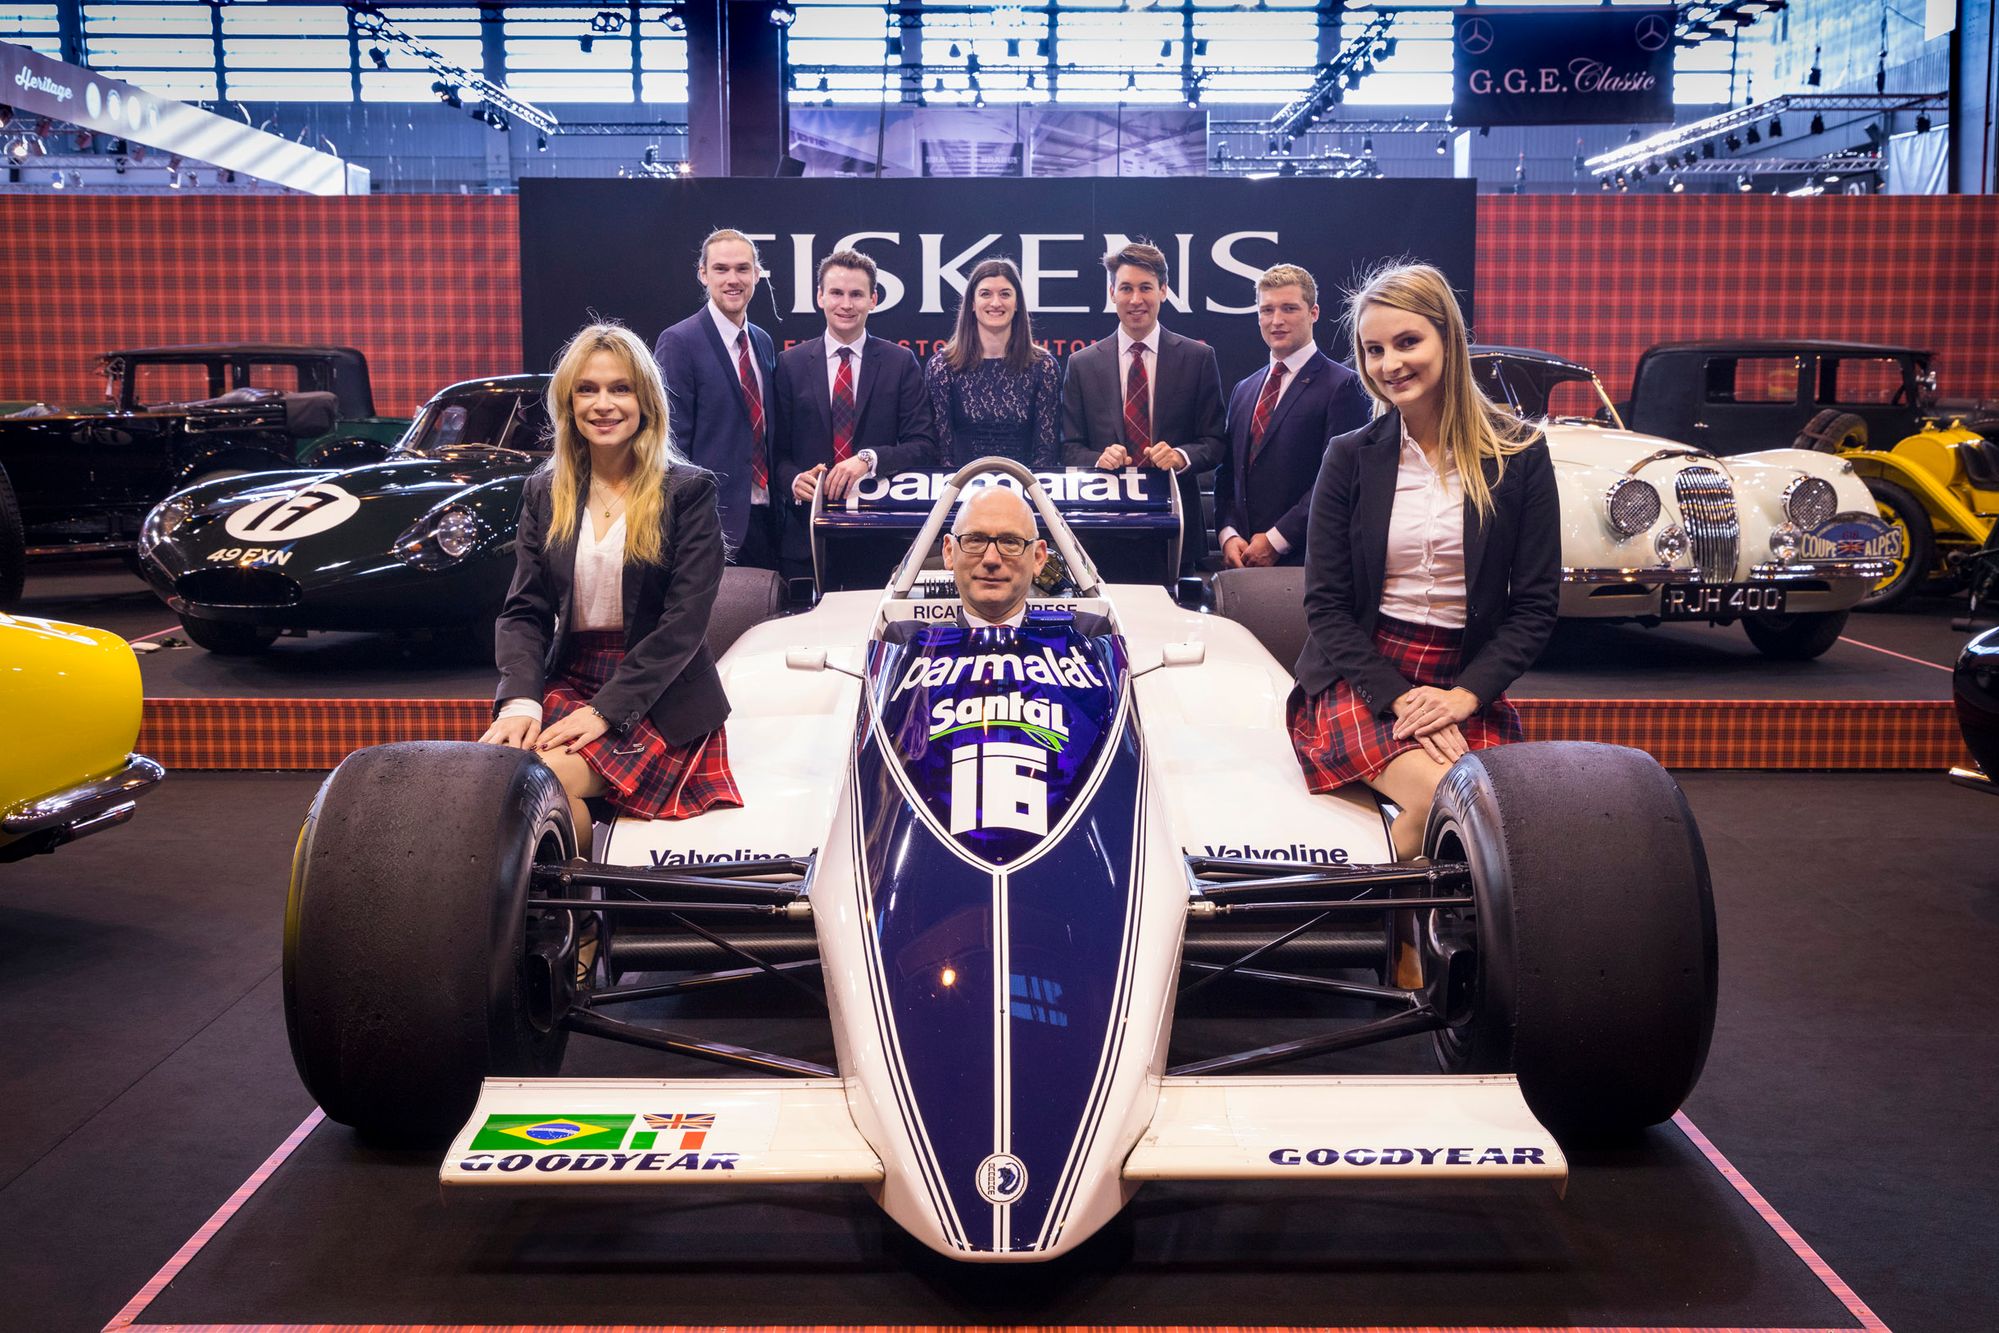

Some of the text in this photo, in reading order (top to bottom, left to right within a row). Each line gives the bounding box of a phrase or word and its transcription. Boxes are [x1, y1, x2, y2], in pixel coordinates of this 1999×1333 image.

[15, 66, 74, 102] Heritage
[1469, 57, 1657, 94] G.G.E. Classic
[242, 491, 340, 531] 17
[206, 547, 243, 562] 49
[1801, 532, 1838, 557] COUPE
[1864, 529, 1900, 556] ALPES
[913, 605, 964, 619] RICA
[1670, 588, 1780, 613] RJH 400
[890, 646, 1104, 702] parmalat
[950, 741, 1049, 837] 16
[1204, 844, 1349, 864] Valvoline
[459, 1152, 741, 1172] GOODYEAR
[1268, 1148, 1547, 1166] GOODYEAR
